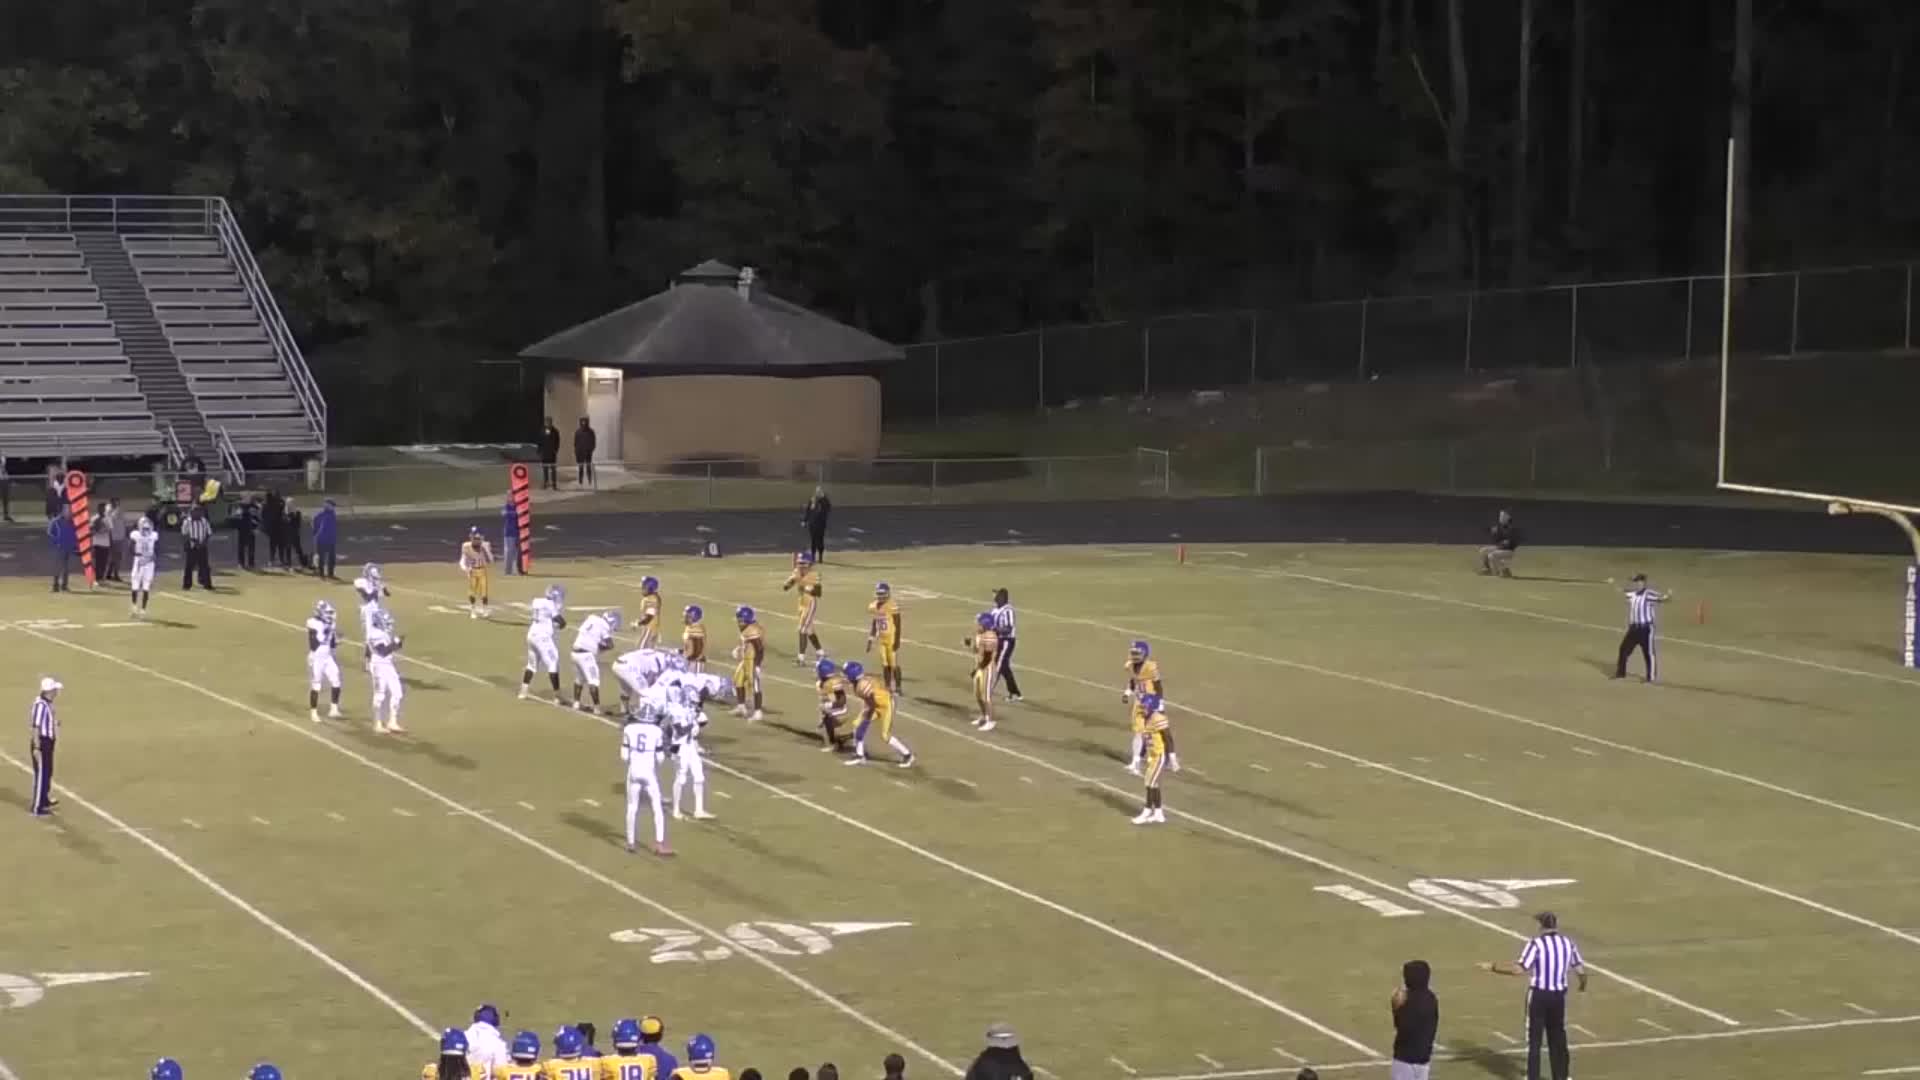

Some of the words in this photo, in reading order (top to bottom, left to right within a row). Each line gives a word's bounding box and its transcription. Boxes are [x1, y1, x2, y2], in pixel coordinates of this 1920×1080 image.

[636, 733, 647, 753] 6
[1312, 878, 1520, 917] 10
[609, 921, 832, 964] 20
